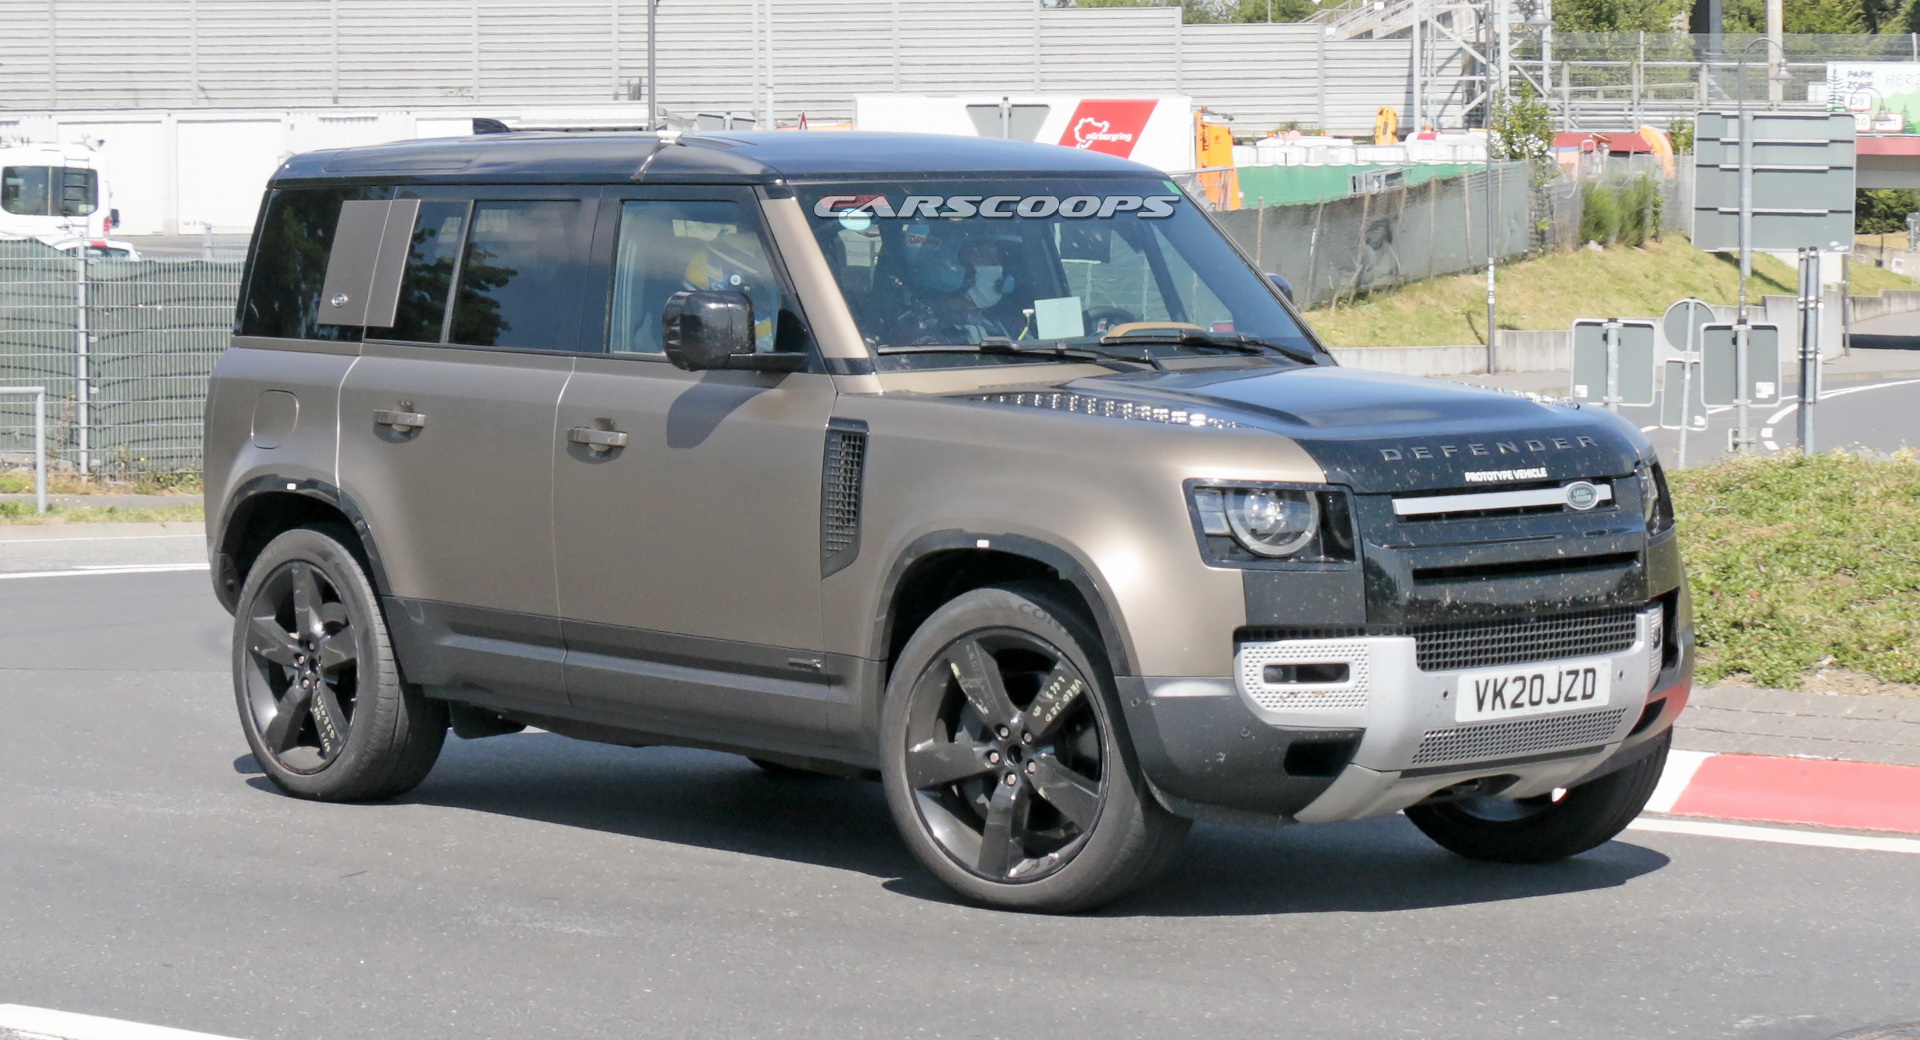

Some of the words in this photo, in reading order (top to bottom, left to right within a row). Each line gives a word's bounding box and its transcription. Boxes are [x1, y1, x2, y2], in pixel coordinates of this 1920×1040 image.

[1847, 70, 1873, 79] PARK
[1380, 436, 1598, 462] DEFENDER
[1464, 471, 1513, 482] PROTOTYPE
[1512, 467, 1548, 479] VEHICLE
